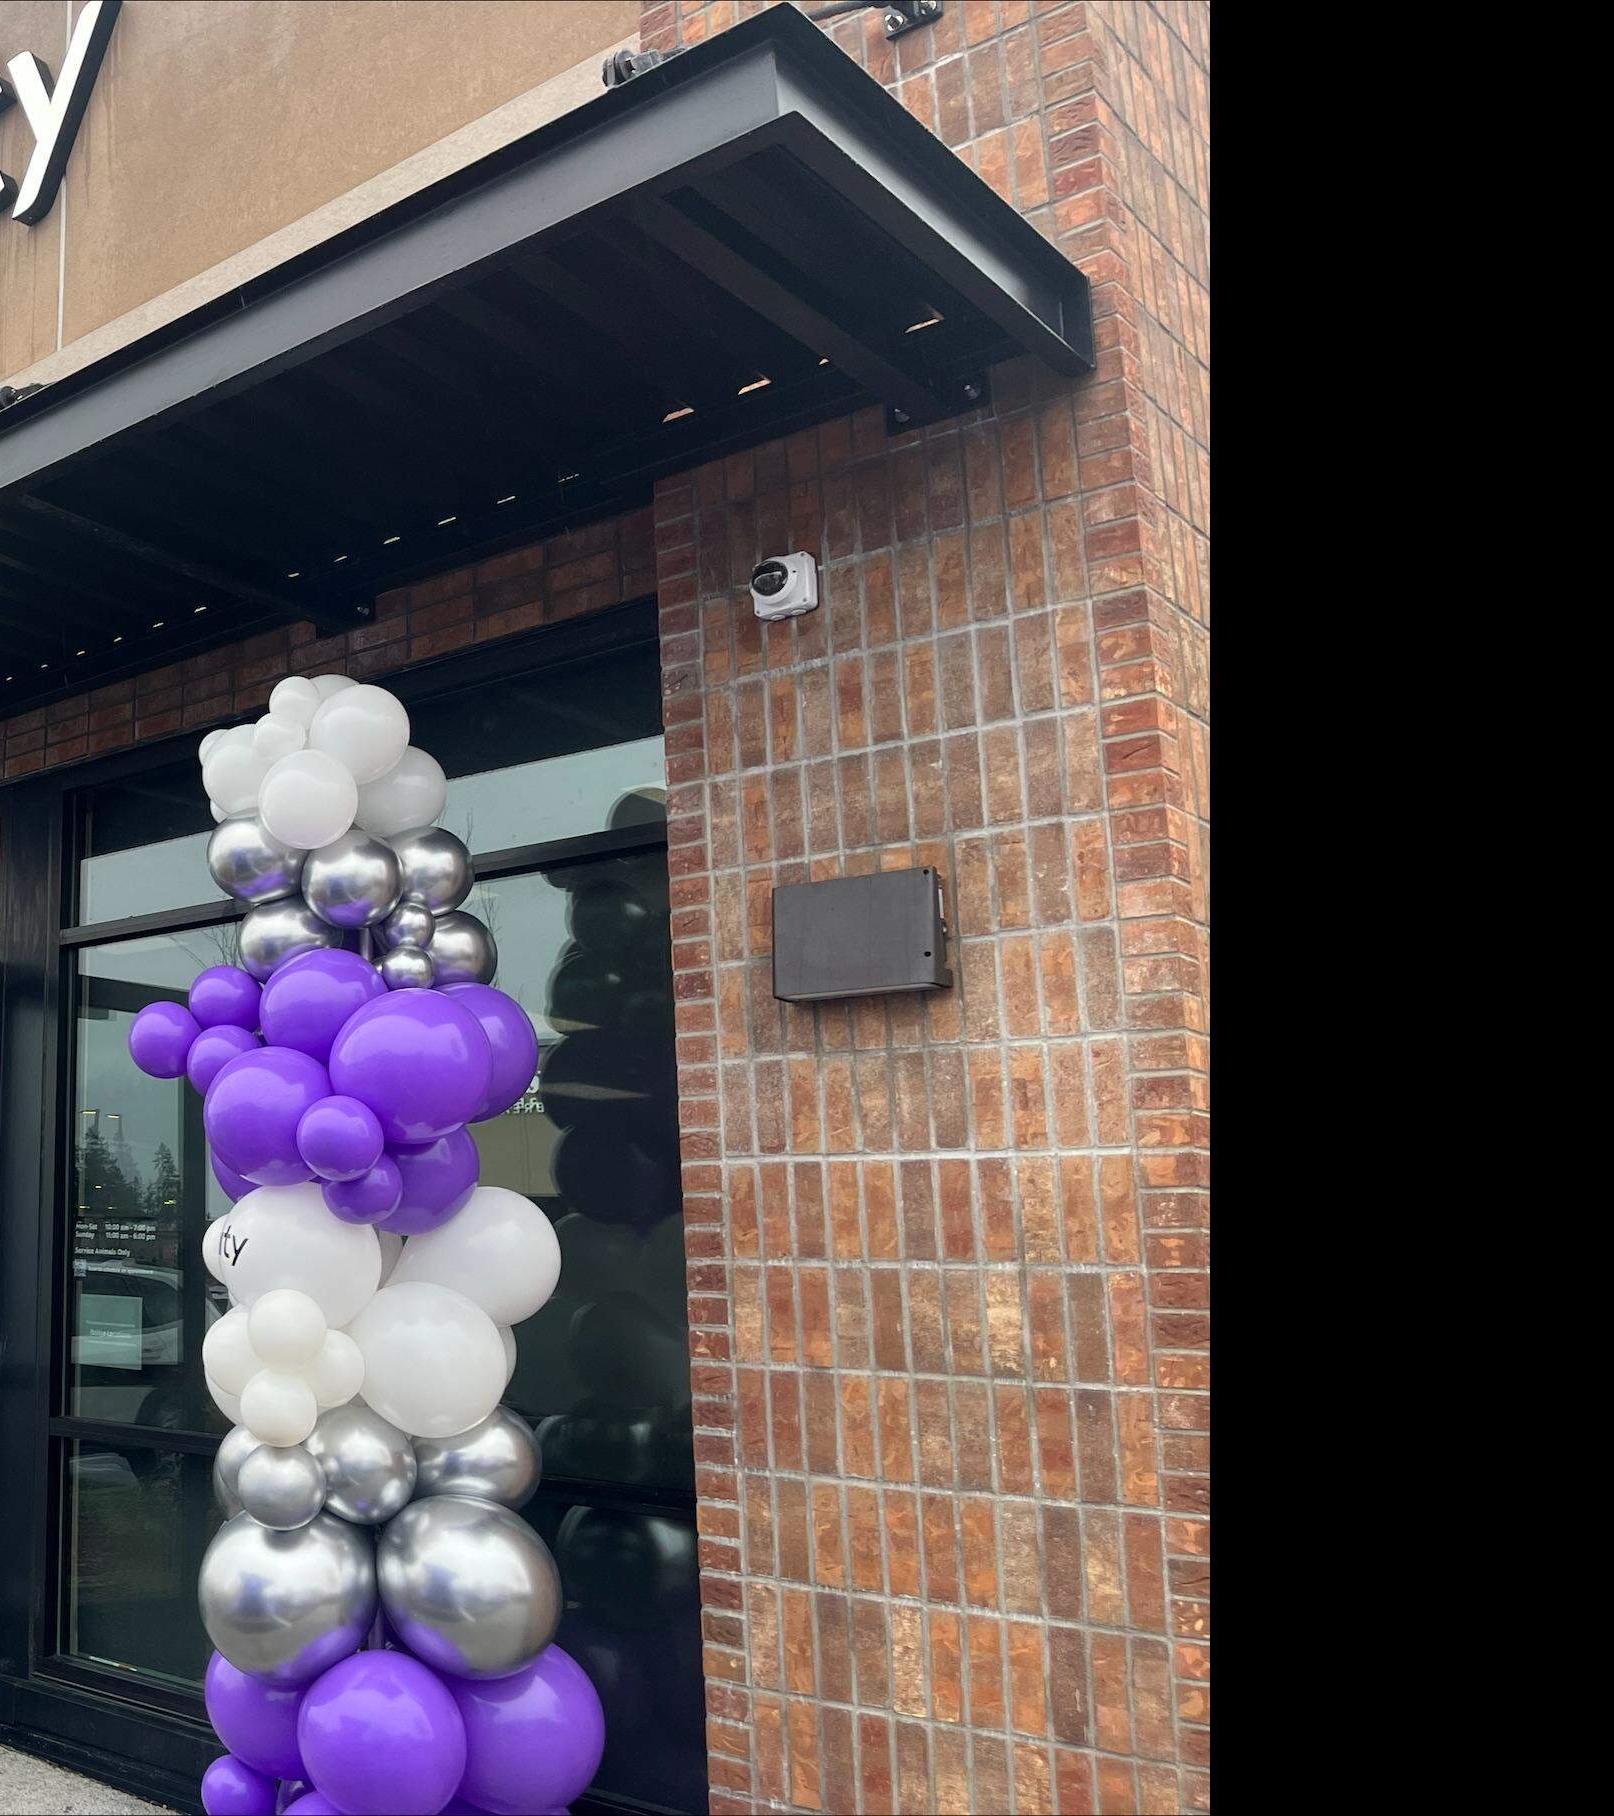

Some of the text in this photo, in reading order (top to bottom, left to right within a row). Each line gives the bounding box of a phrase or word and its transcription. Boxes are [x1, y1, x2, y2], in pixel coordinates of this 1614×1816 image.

[75, 1230, 95, 1240] Sunday
[75, 1246, 95, 1255] Service
[117, 1248, 131, 1258] Only
